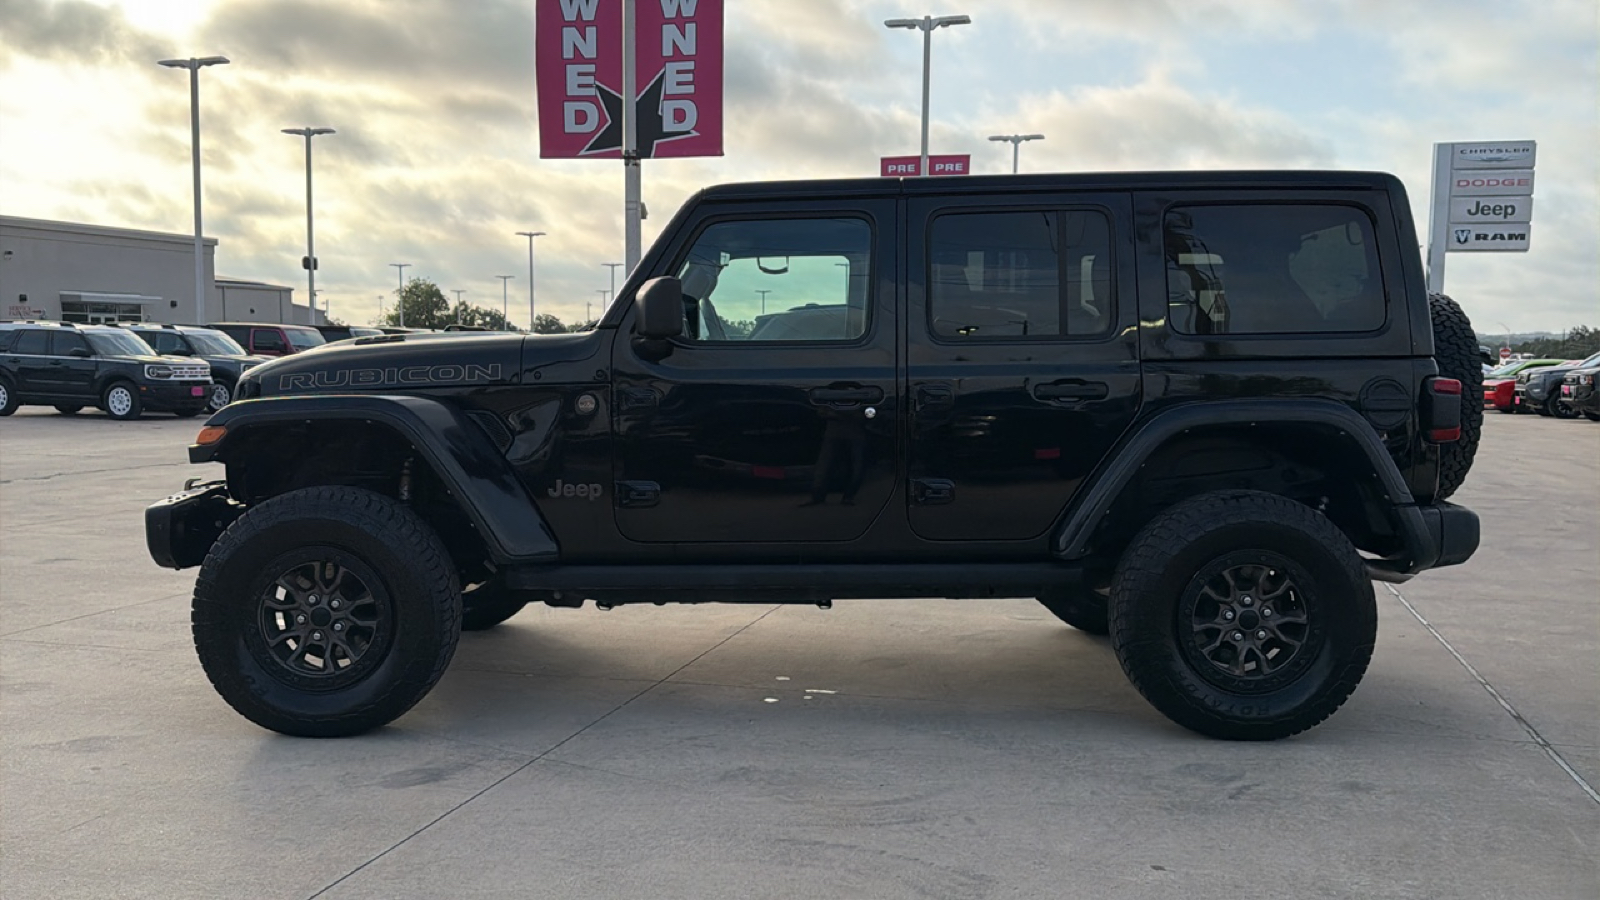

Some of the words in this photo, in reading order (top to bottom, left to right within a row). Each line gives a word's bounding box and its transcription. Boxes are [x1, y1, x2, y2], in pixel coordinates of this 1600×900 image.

[888, 164, 916, 173] PRE
[935, 163, 963, 172] PRE
[1456, 179, 1530, 187] DODGE
[1467, 201, 1516, 219] Jeep
[1474, 233, 1526, 241] RAM
[279, 363, 501, 390] RUBICON
[548, 479, 602, 501] Jeep
